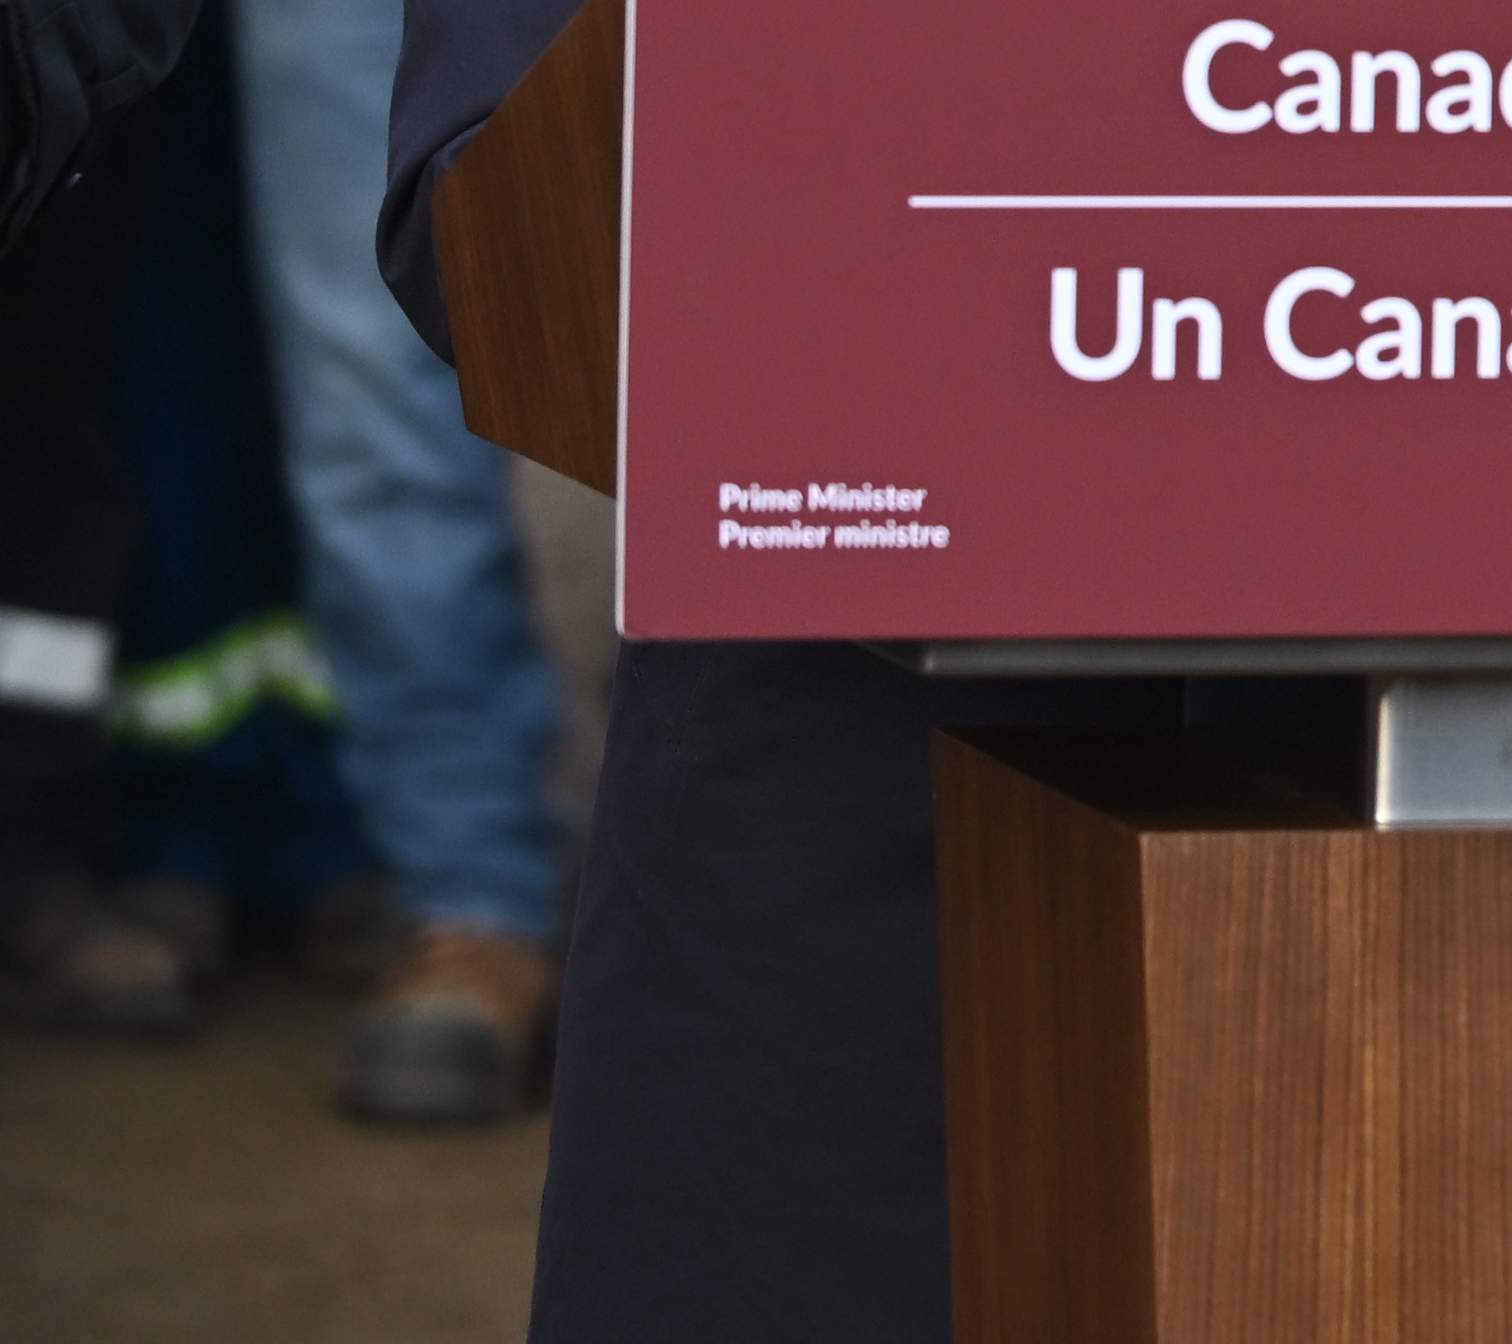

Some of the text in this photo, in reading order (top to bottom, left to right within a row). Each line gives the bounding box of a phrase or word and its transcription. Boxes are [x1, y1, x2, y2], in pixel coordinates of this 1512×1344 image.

[1050, 267, 1223, 382] Un
[719, 482, 927, 512] Prime Minister
[719, 519, 950, 549] Premier ministre
